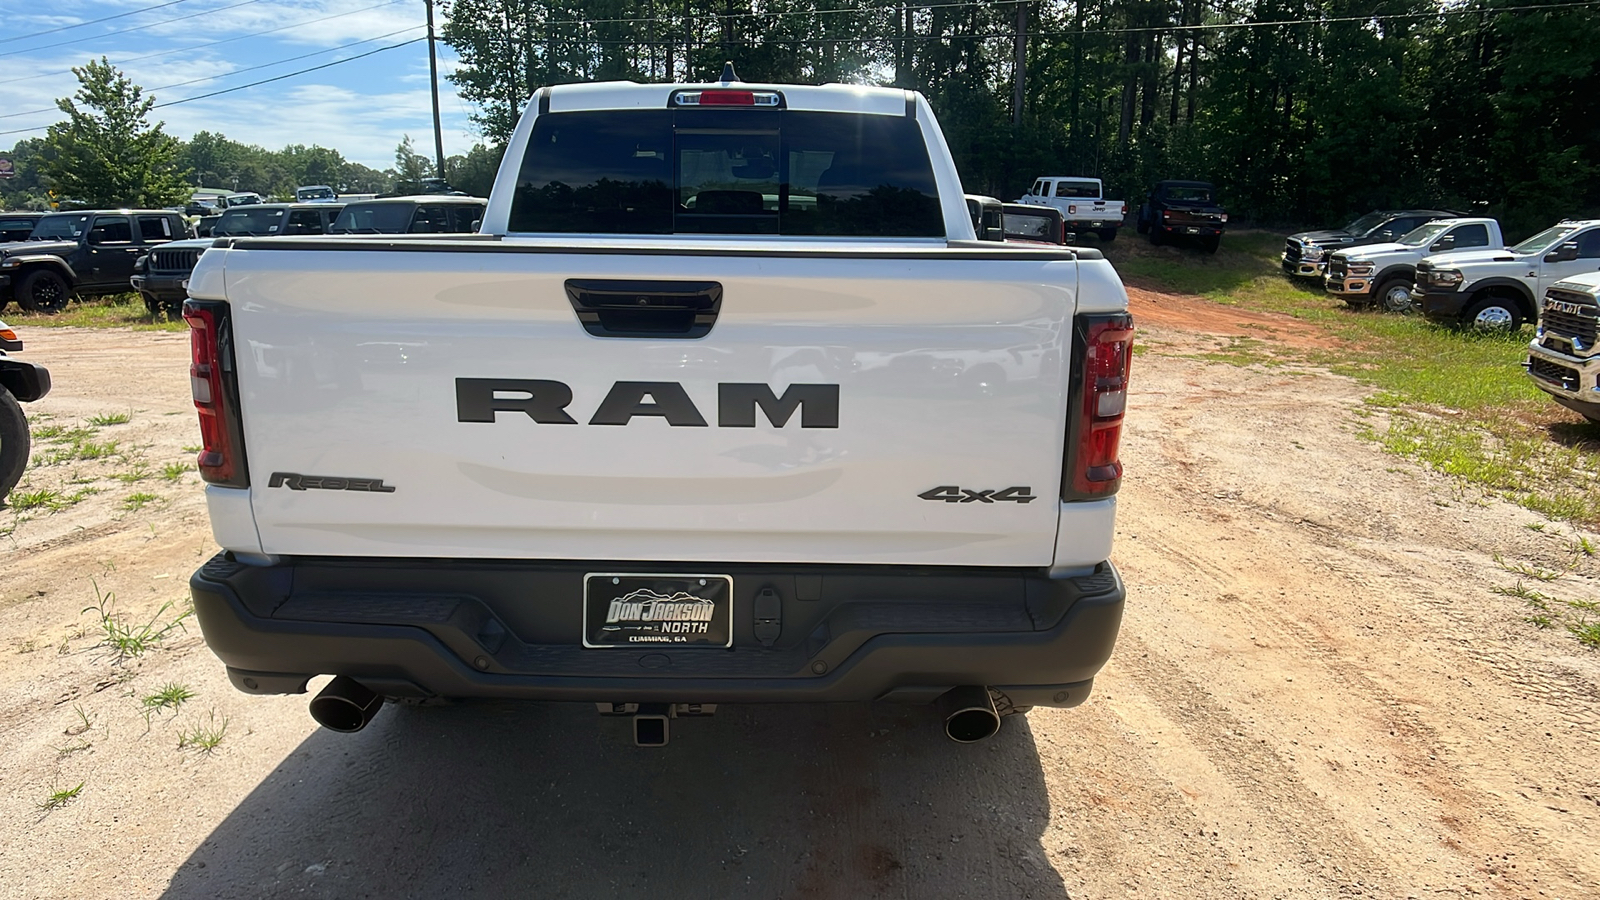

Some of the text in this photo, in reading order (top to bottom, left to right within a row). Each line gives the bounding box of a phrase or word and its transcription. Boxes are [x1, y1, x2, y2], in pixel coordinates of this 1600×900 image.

[455, 377, 840, 429] RAM
[268, 472, 396, 493] REBEL
[917, 486, 1037, 503] 4x4
[606, 601, 715, 623] DON JACKSON
[661, 622, 709, 633] NORTH
